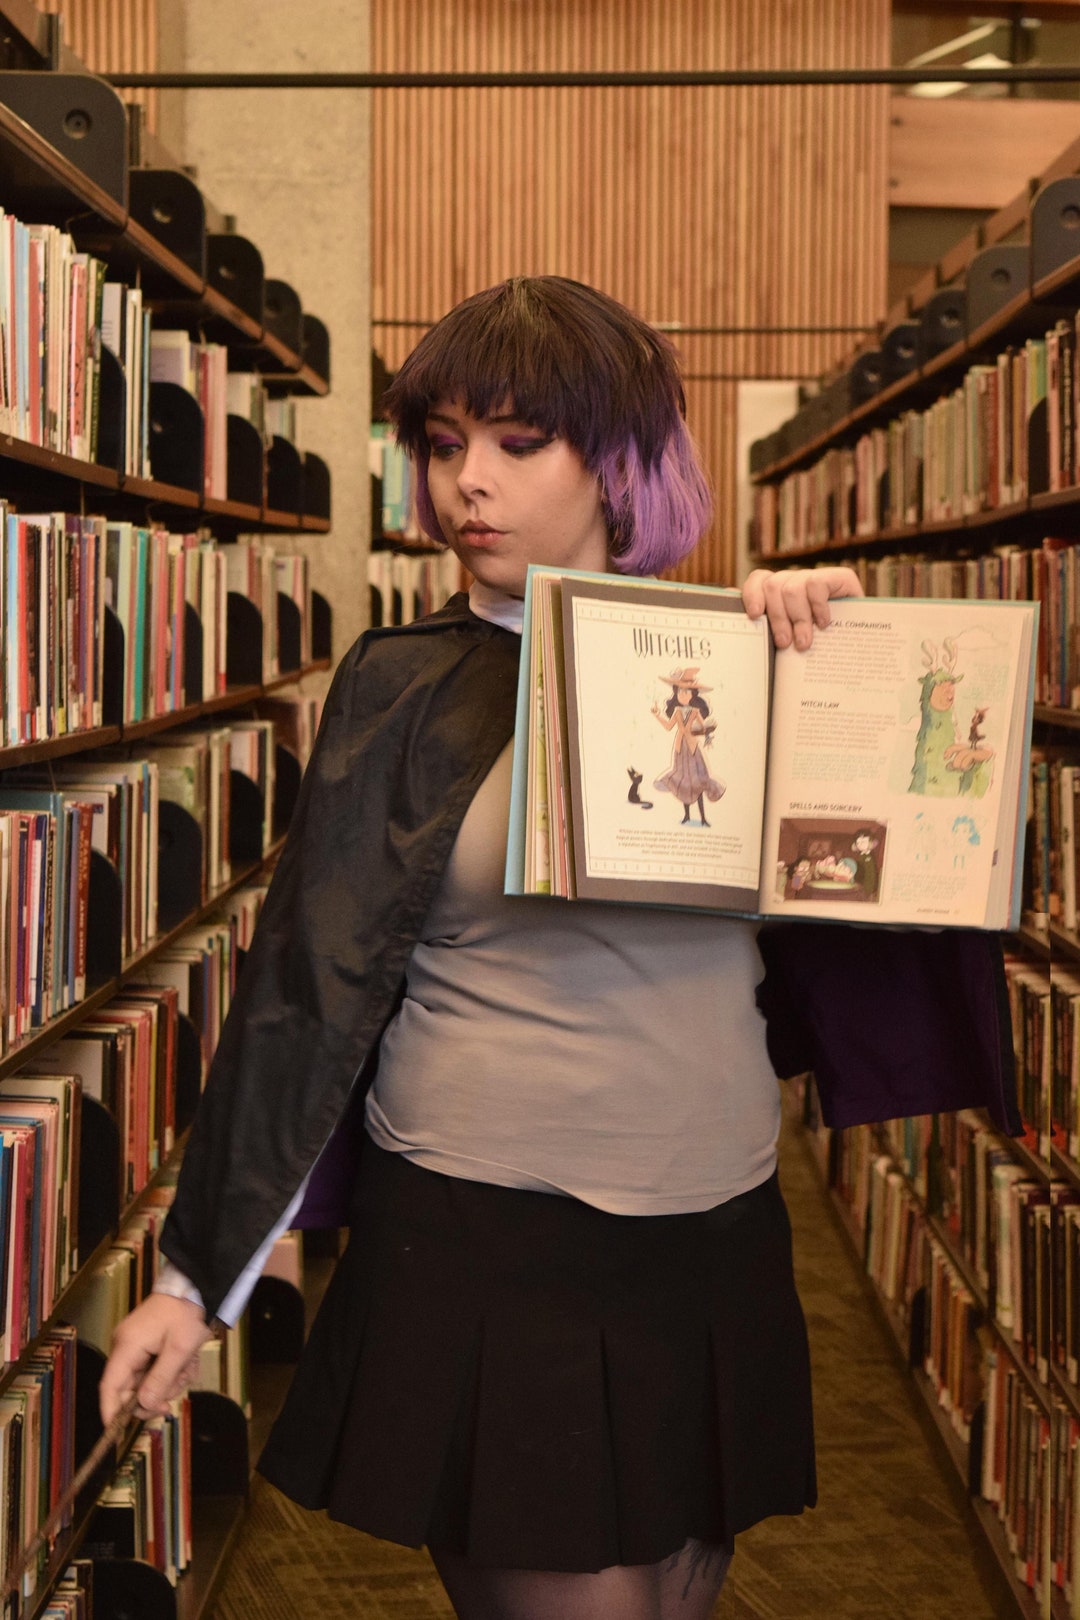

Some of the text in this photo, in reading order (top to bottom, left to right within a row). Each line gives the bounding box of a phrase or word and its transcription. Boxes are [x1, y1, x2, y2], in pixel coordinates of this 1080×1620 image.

[845, 620, 892, 631] COMPANIONS
[632, 627, 712, 660] WITCHES
[801, 700, 823, 708] WITCH
[789, 802, 812, 810] SPELLS
[830, 803, 863, 812] SORCERY
